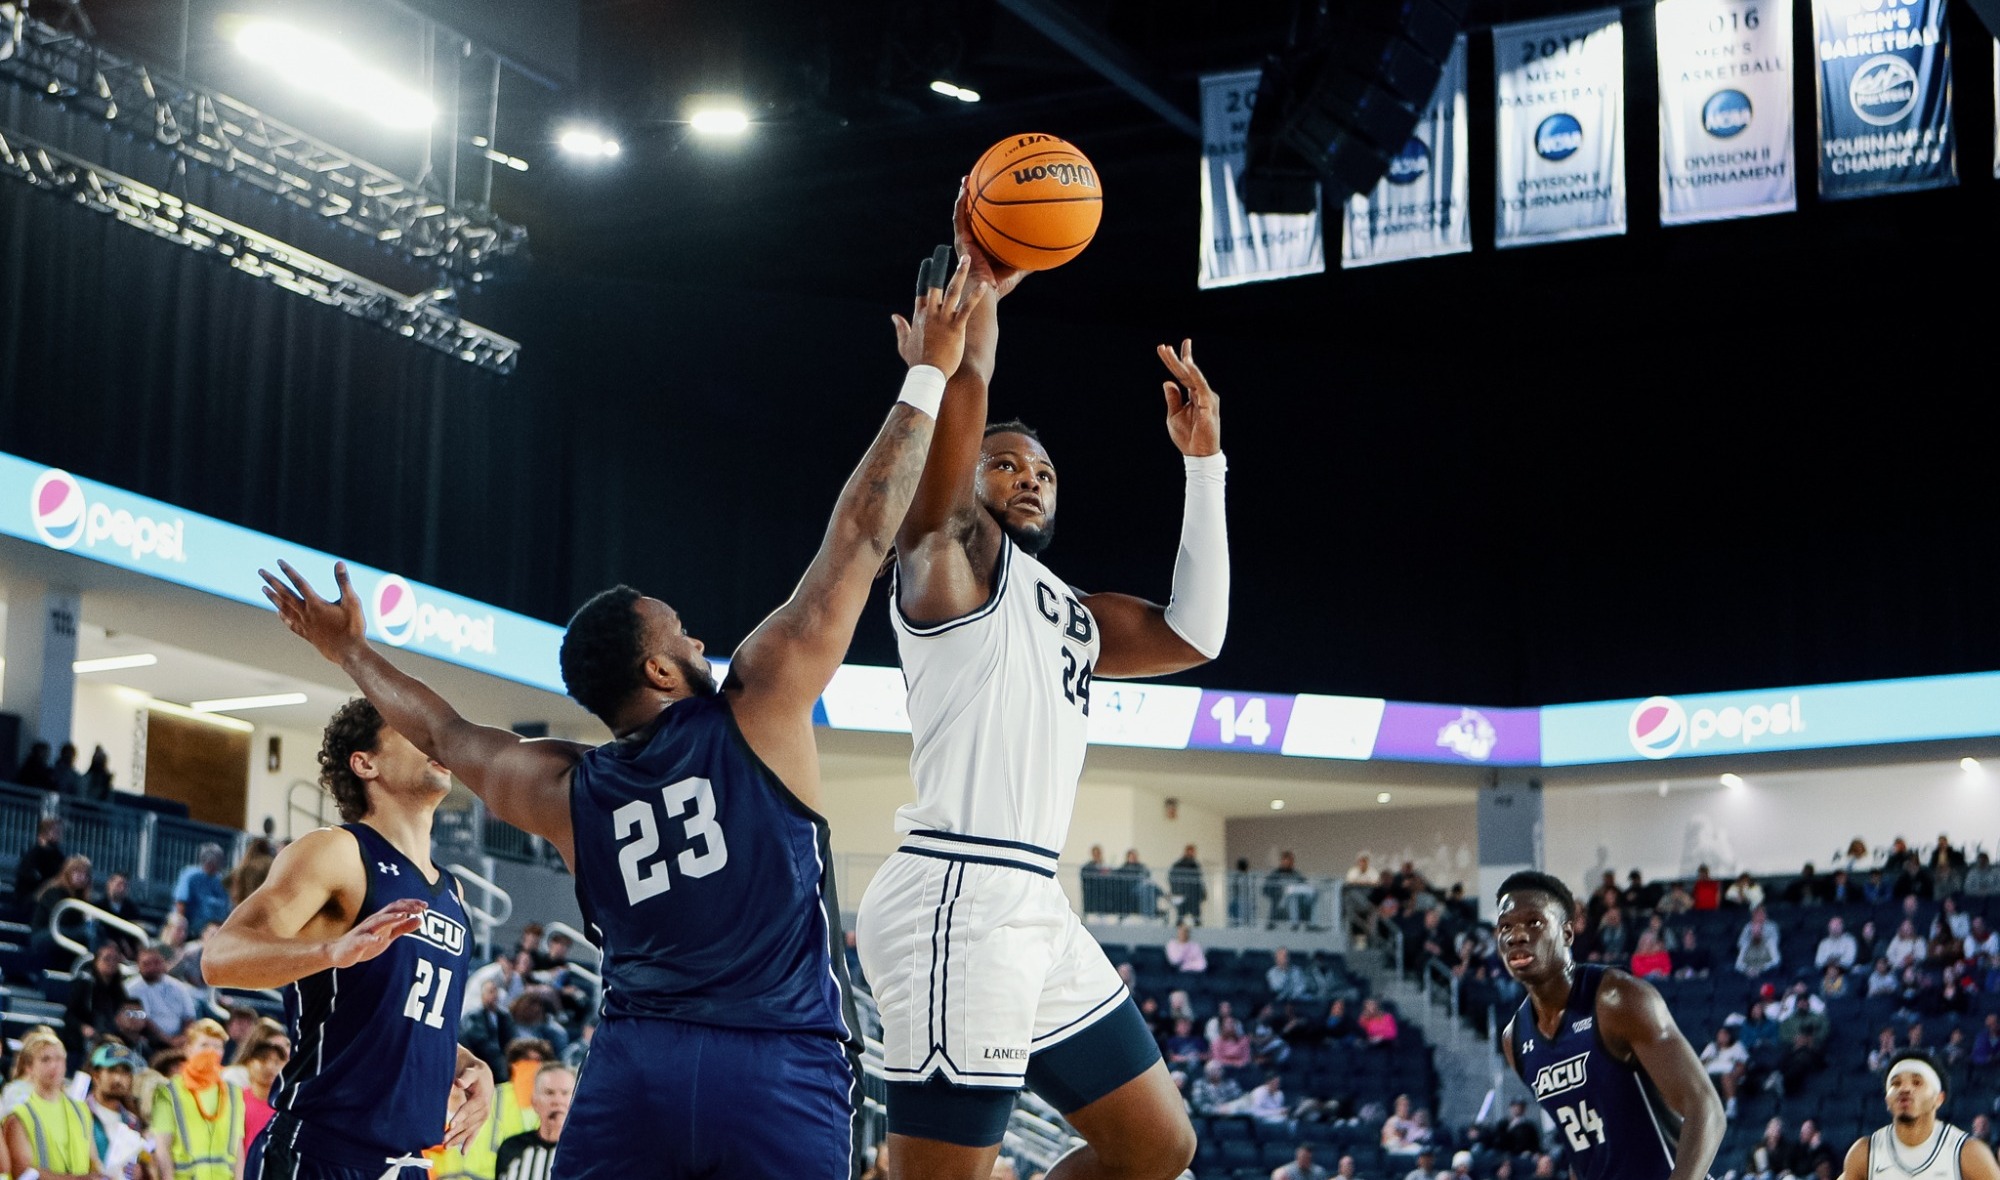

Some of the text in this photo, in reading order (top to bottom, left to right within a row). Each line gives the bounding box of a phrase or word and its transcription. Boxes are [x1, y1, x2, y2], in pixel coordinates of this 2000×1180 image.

[1708, 7, 1760, 33] 016
[1681, 56, 1784, 82] ASKETBALL
[1011, 163, 1097, 189] Wilson
[86, 502, 185, 561] pepsi
[416, 602, 495, 653] pepsi
[1061, 645, 1092, 717] 24
[1211, 696, 1271, 746] 14
[1690, 695, 1802, 748] pepsi
[613, 776, 728, 906] 23
[403, 957, 453, 1029] 21
[983, 1048, 1028, 1060] LANCERS
[1536, 1058, 1585, 1097] ACU
[1556, 1099, 1606, 1153] 24
